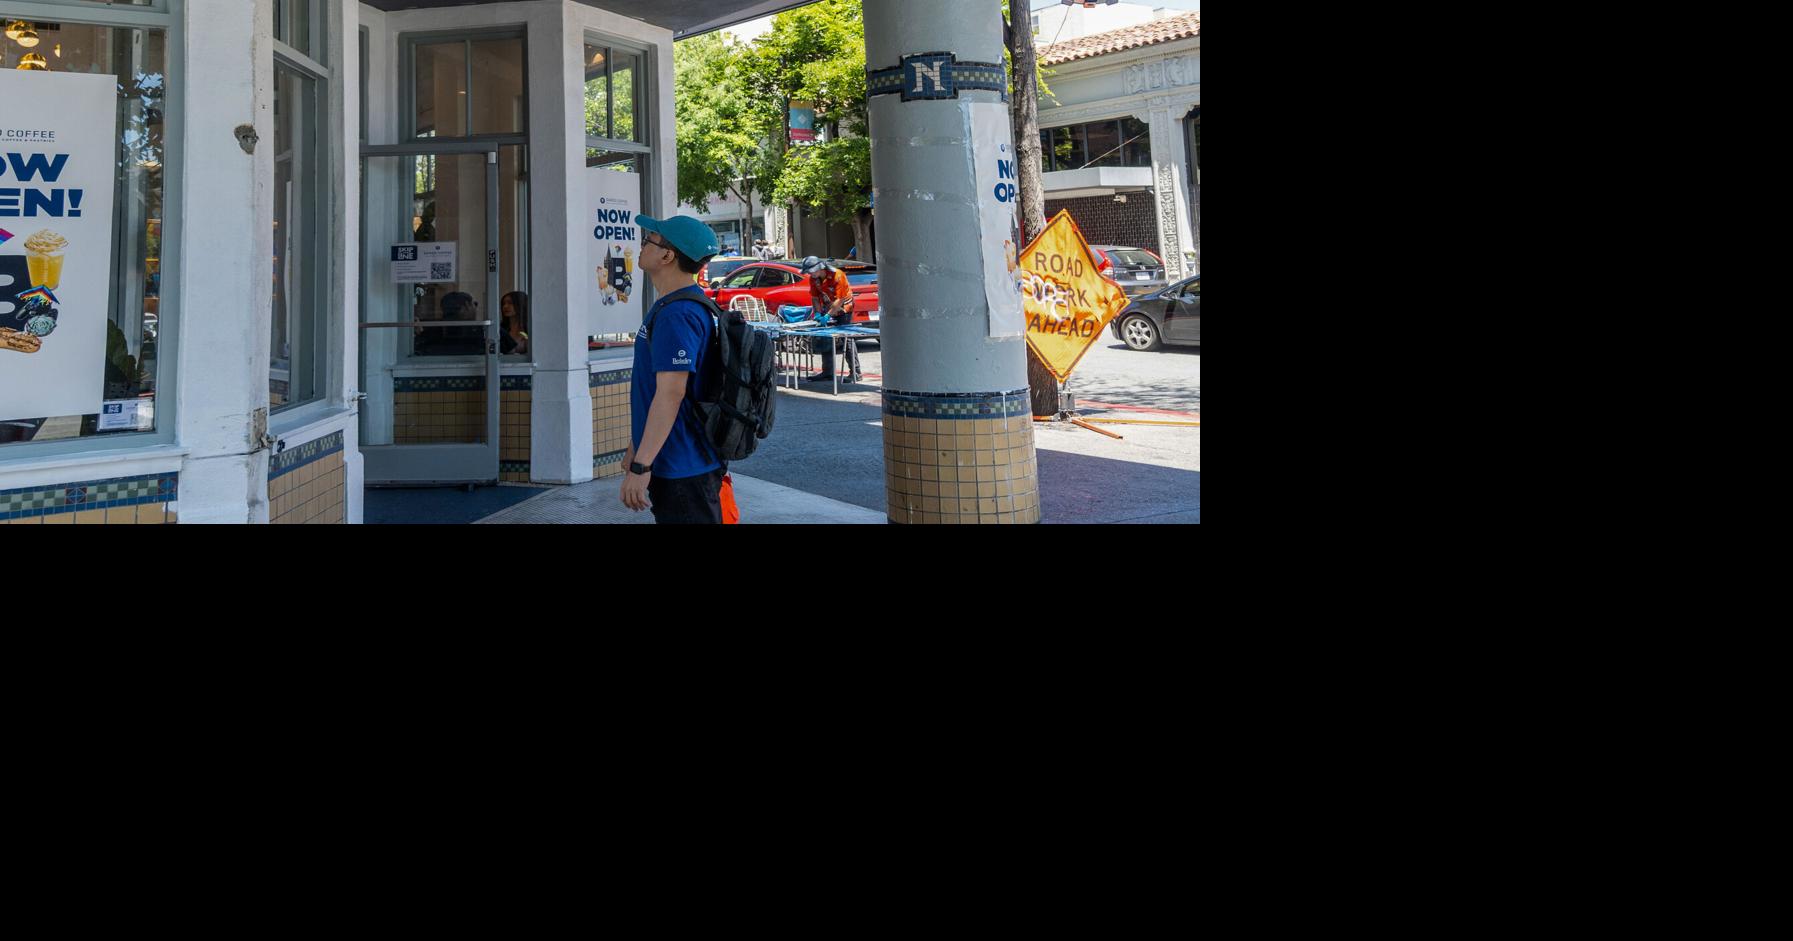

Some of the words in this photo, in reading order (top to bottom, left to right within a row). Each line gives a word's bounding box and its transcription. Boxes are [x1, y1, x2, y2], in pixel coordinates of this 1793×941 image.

[911, 61, 946, 92] N
[7, 129, 55, 139] COFFEE
[0, 152, 70, 182] W
[993, 182, 1017, 203] OP
[597, 208, 631, 224] NOW
[593, 225, 635, 240] OPEN!
[1035, 252, 1083, 278] ROAD
[1027, 313, 1095, 338] AHEAD
